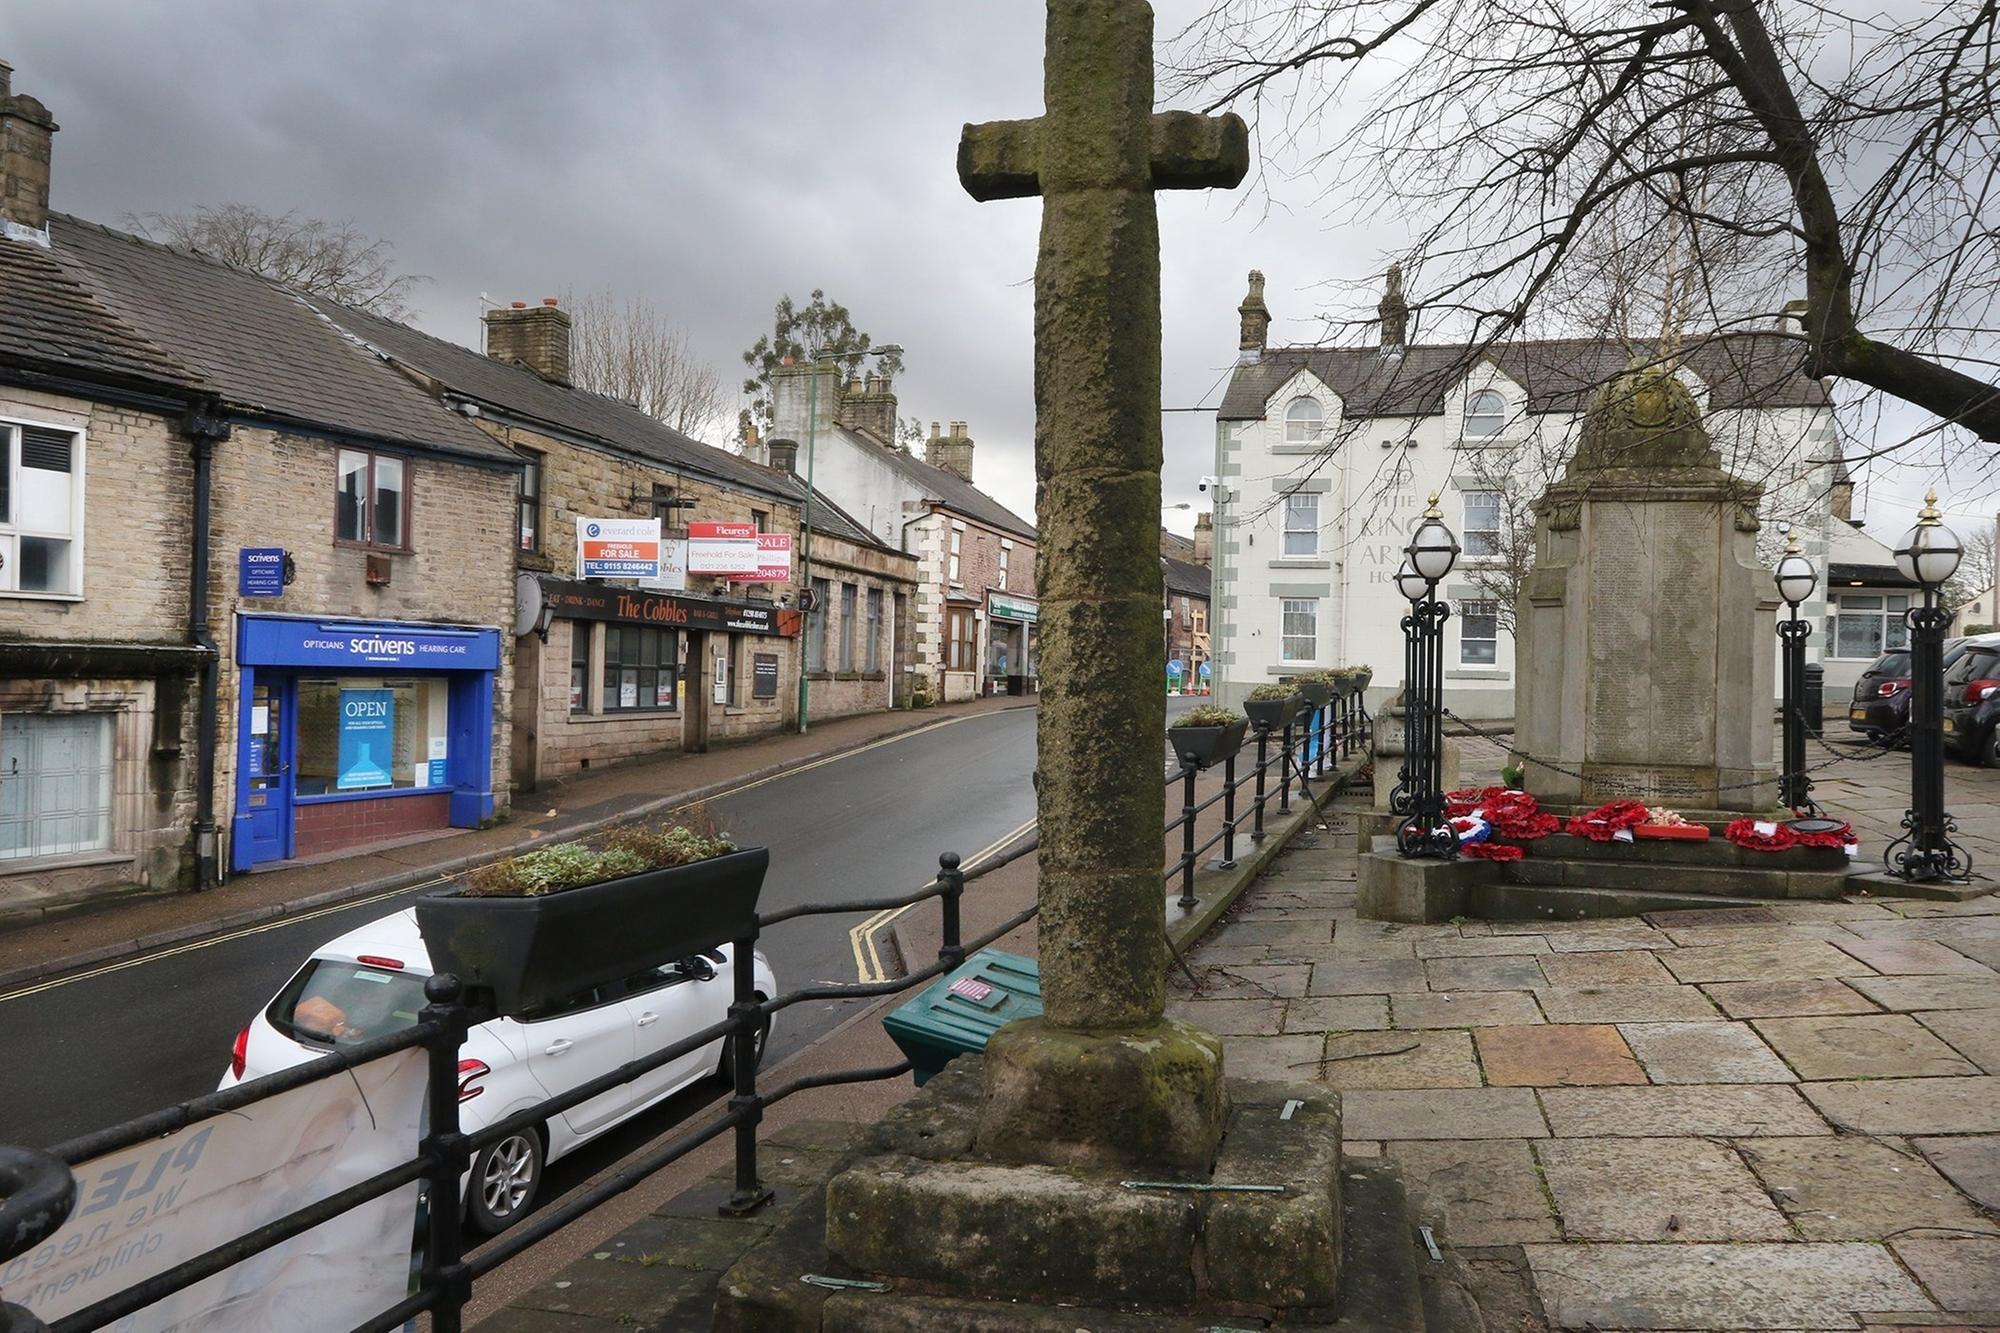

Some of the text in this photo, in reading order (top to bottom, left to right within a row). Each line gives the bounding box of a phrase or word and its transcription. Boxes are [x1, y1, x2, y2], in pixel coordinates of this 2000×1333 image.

[716, 526, 751, 535] Fleurets
[757, 538, 787, 548] SALE
[248, 552, 280, 562] scrivens
[600, 549, 640, 559] FOR SALE
[585, 561, 602, 570] TEL:
[603, 561, 621, 570] 0115
[617, 595, 689, 624] The Cobbles
[303, 634, 467, 655] OPTICIANS scrivens HEARING CARE
[345, 701, 387, 717] OPEN
